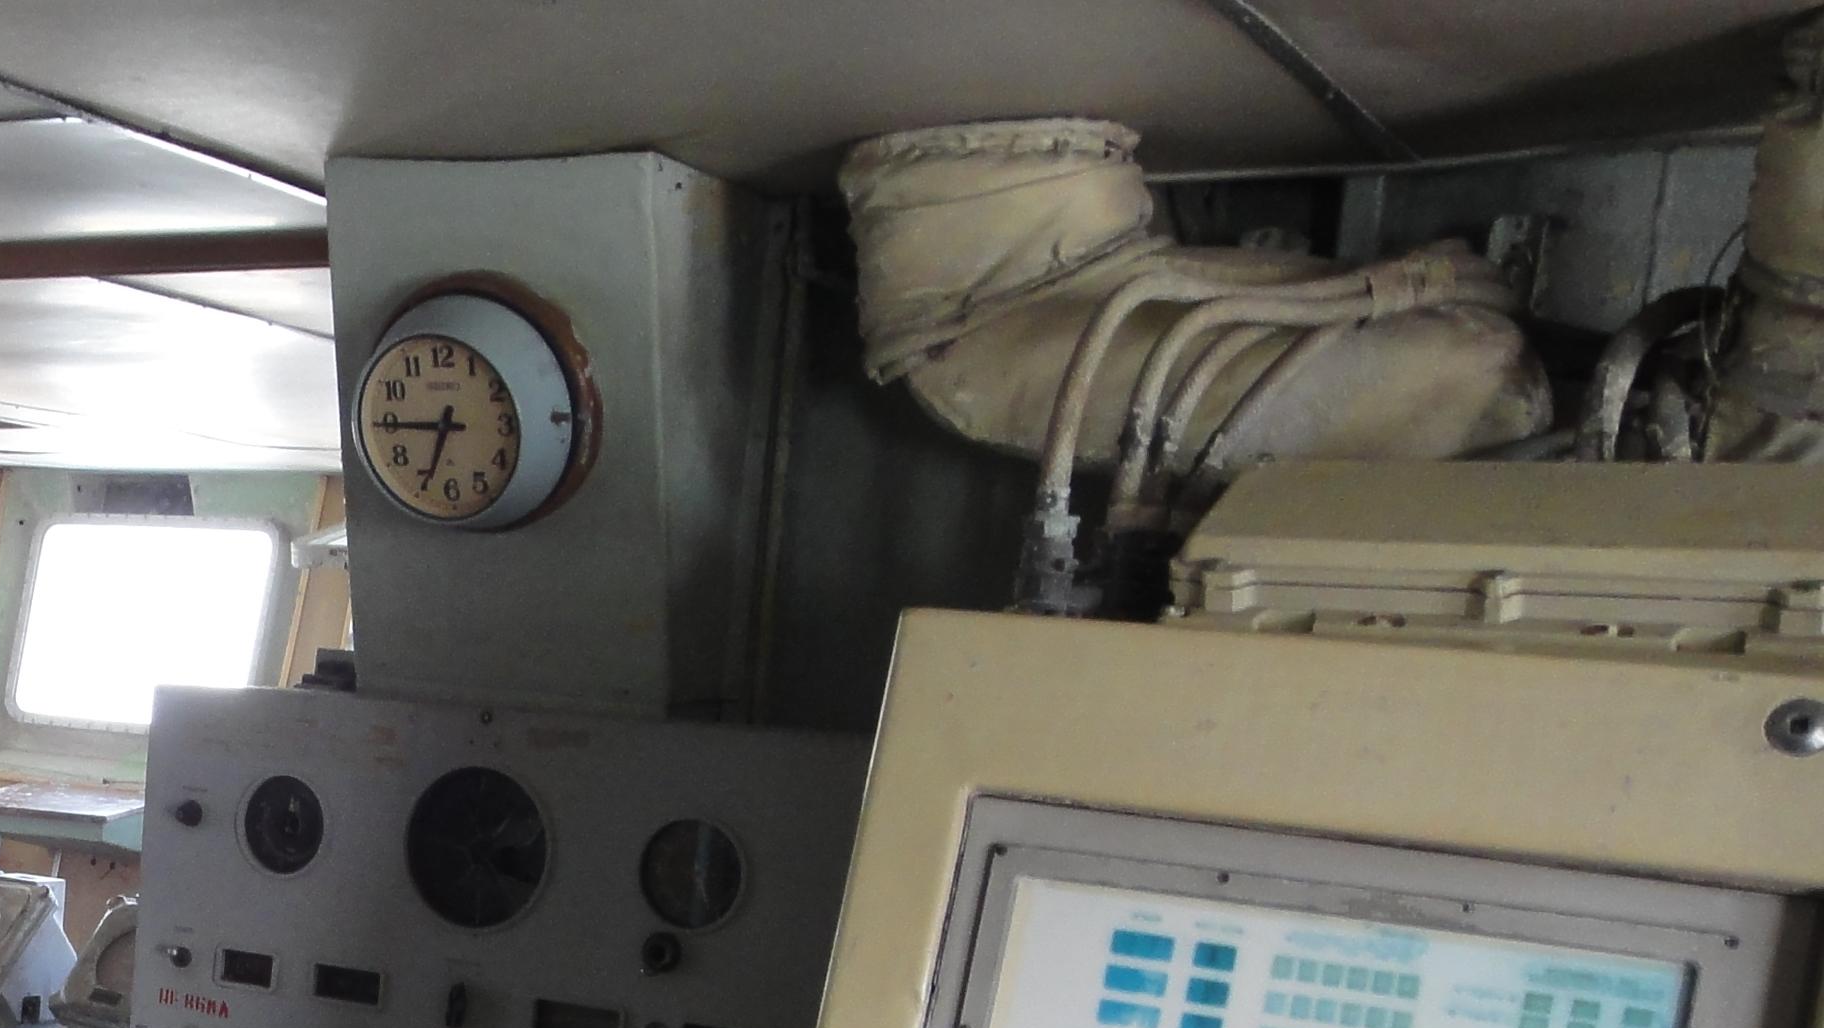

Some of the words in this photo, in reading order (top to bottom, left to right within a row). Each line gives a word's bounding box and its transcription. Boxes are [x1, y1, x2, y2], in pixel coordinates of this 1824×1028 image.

[405, 356, 421, 377] 11
[431, 345, 455, 368] 12
[466, 357, 476, 376] 1
[385, 379, 405, 401] 10
[488, 380, 504, 402] 2
[384, 413, 398, 434] 9
[497, 414, 513, 436] 3
[393, 445, 408, 466] 8
[492, 448, 507, 470] 4
[417, 469, 433, 491] 7
[444, 478, 460, 501] 6
[473, 471, 489, 494] 5
